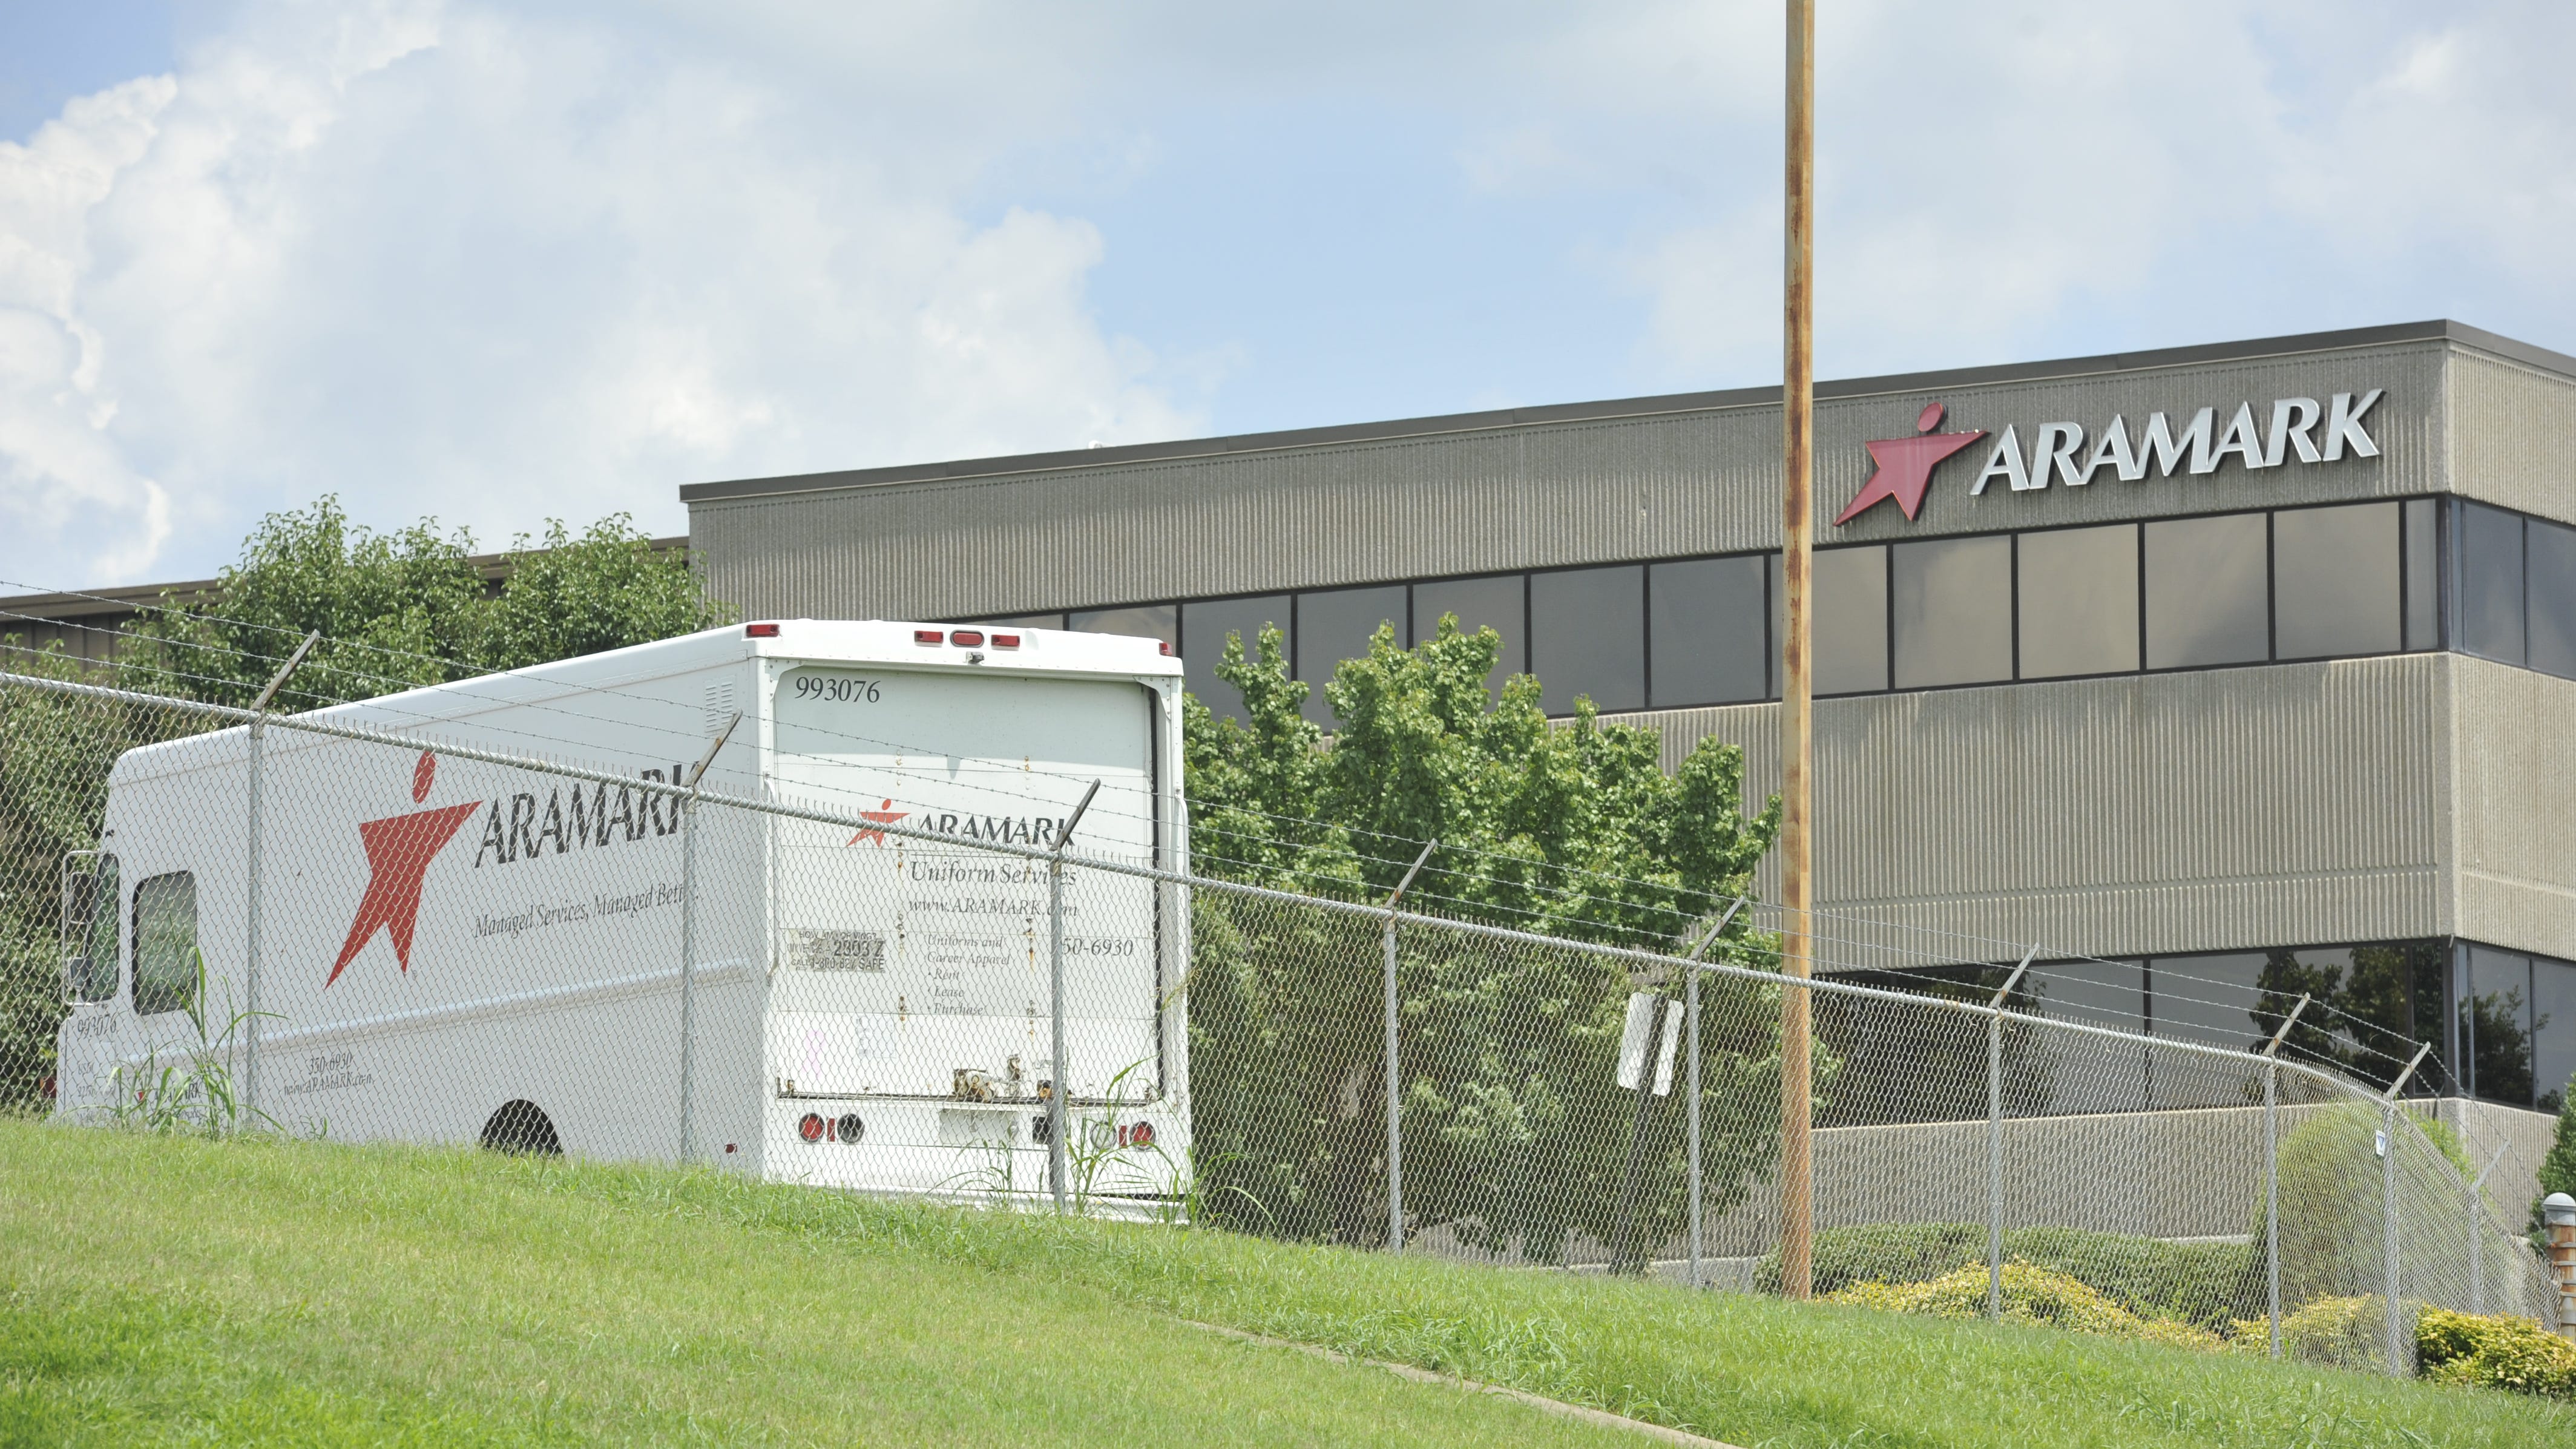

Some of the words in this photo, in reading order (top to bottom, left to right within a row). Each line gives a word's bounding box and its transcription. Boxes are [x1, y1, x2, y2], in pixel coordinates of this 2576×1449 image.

[1969, 389, 2384, 496] ARAMARK
[794, 675, 881, 704] 993076
[914, 813, 1076, 846] ARAMARK
[910, 860, 996, 888] Uniform
[1000, 863, 1077, 885] Servies
[475, 905, 534, 939] Managed
[536, 899, 589, 926] Services,
[593, 884, 653, 919] Managed
[908, 898, 1077, 916] www.ARAMARK.cm
[927, 935, 979, 947] Uniforms
[981, 936, 1003, 948] and
[858, 958, 885, 970] SAFE
[927, 951, 964, 964] Career
[967, 953, 1011, 967] Apparel
[933, 968, 960, 980] Rent
[934, 985, 964, 998] Lease
[933, 1002, 984, 1016] Purchase
